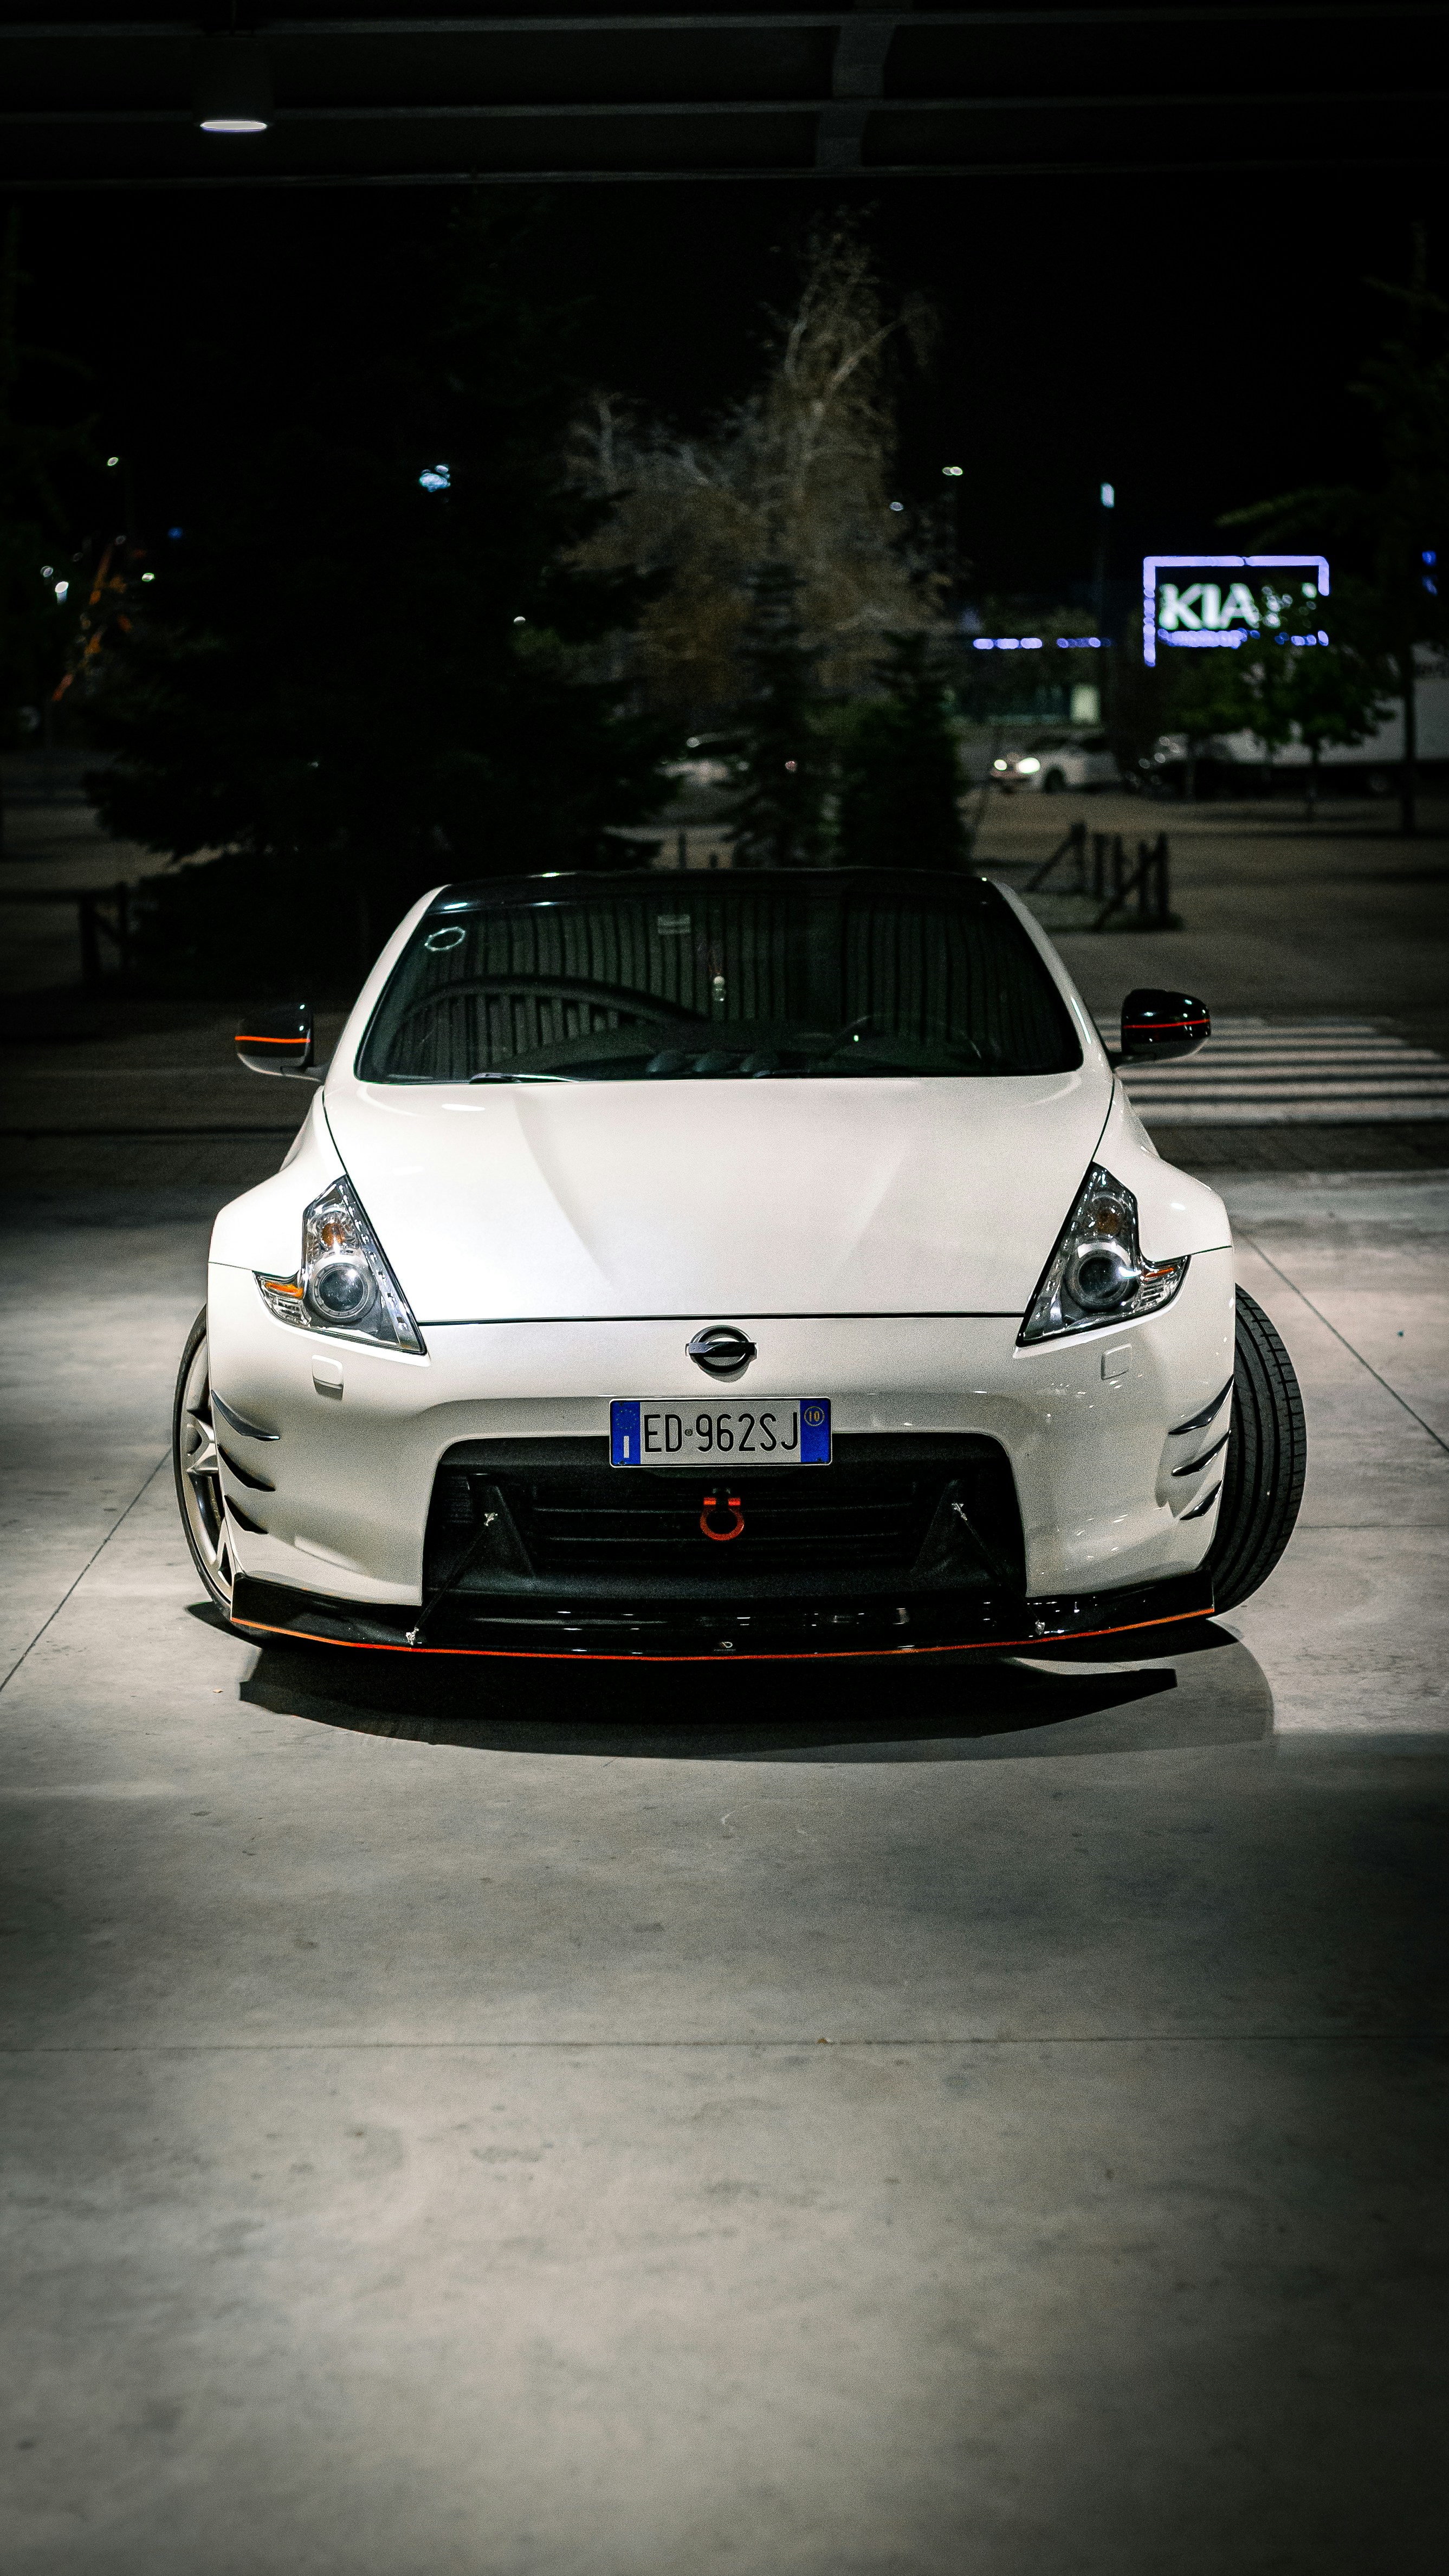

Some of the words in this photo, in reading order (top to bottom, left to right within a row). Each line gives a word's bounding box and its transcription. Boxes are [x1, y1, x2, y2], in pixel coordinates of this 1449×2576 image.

[1159, 584, 1260, 629] KIA
[809, 1410, 820, 1422] 10
[624, 1436, 629, 1458] I
